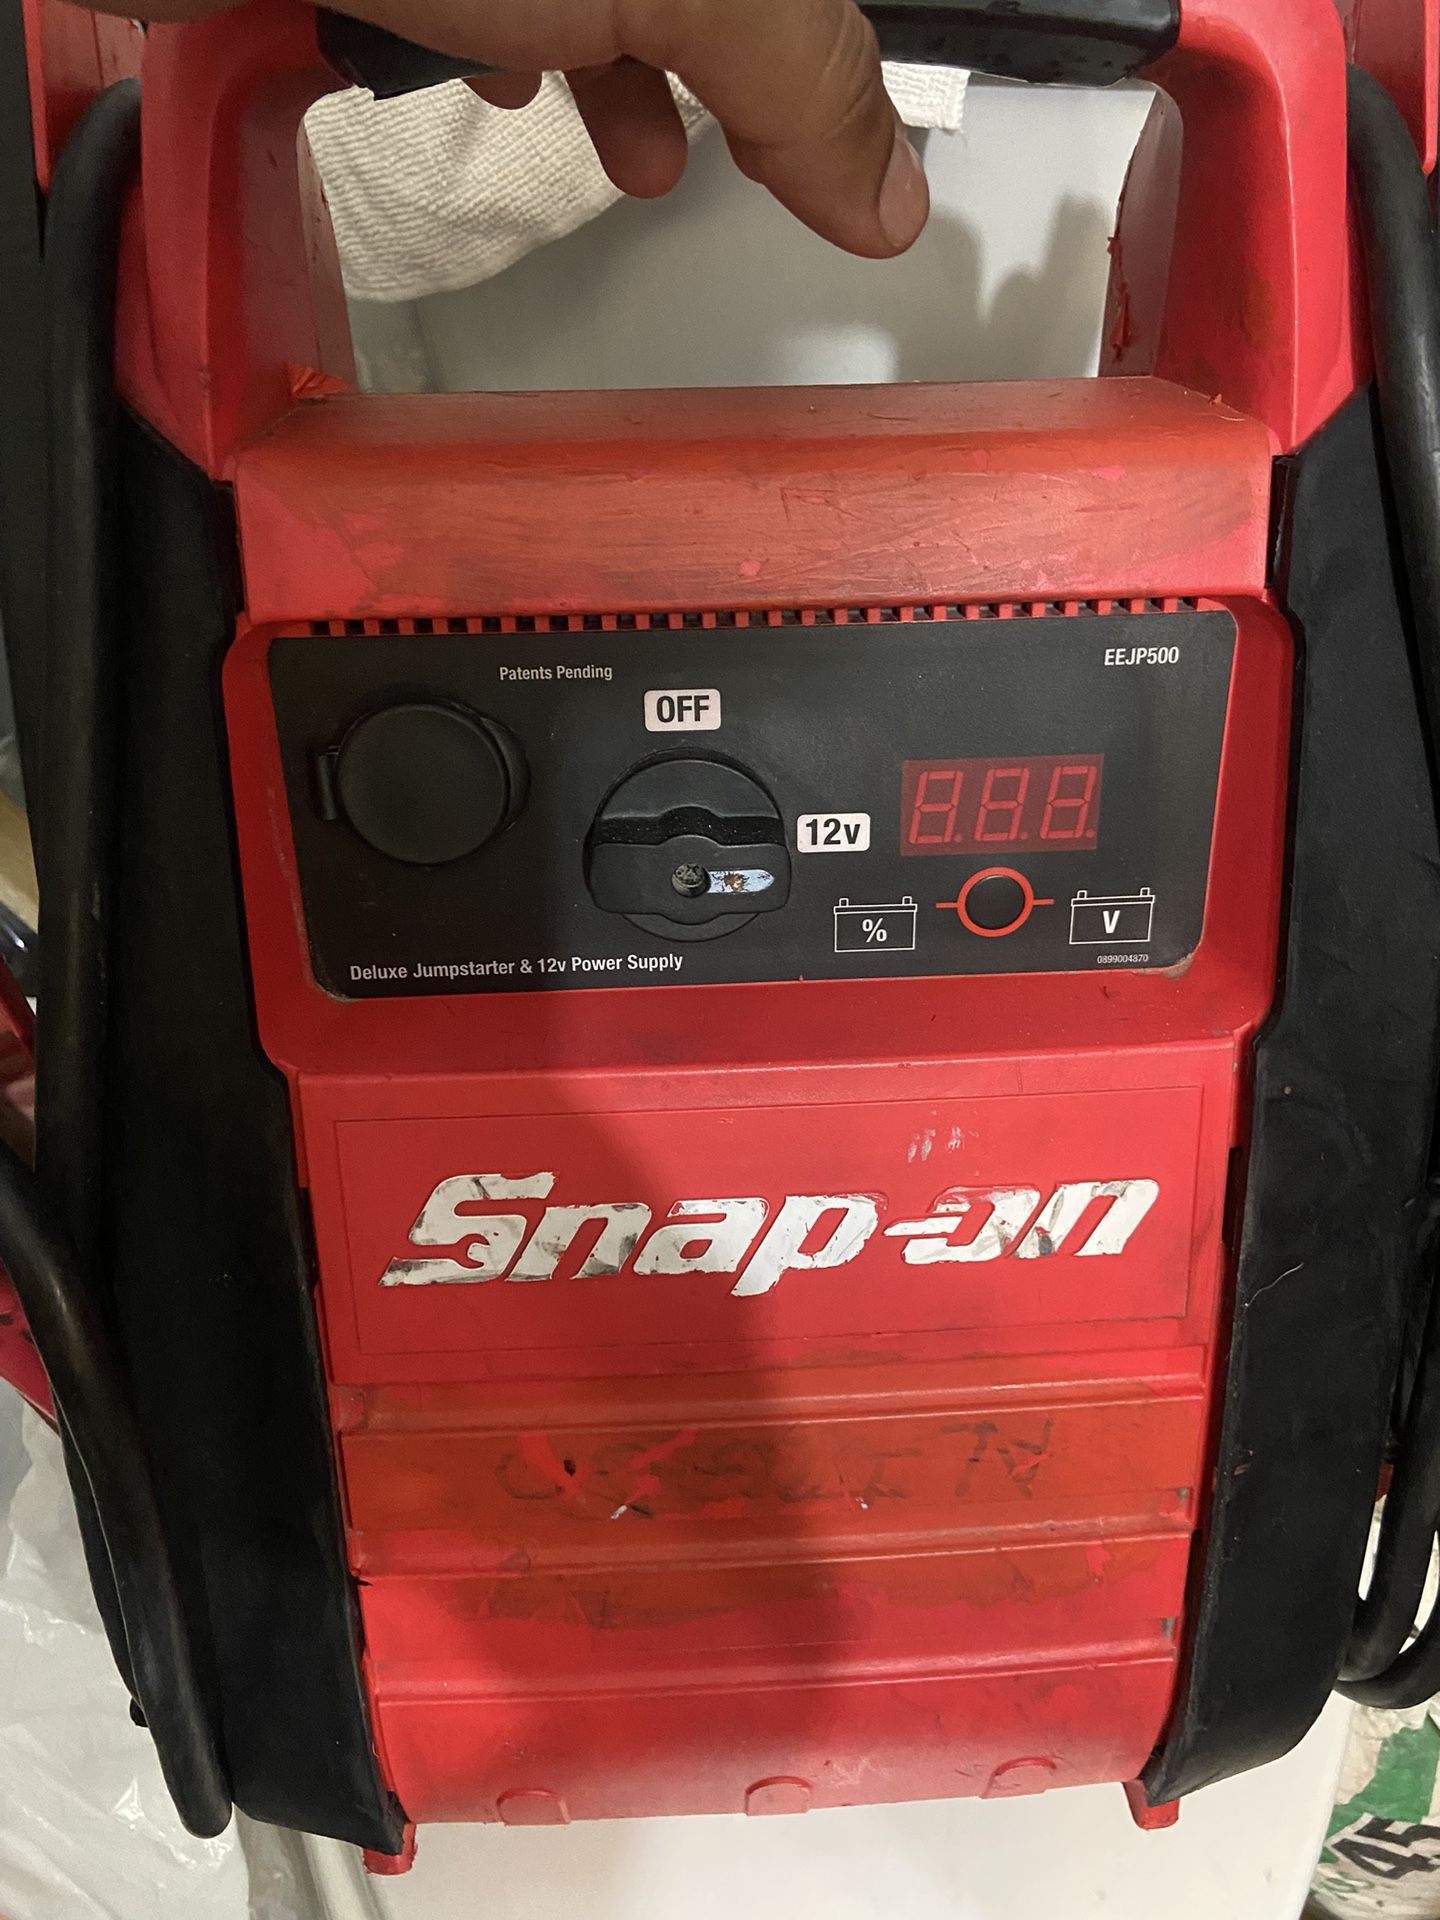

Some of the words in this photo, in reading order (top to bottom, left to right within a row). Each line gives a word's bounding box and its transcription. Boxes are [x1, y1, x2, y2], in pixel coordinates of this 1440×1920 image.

[1104, 646, 1180, 666] EEJP500
[499, 666, 553, 681] Patents
[556, 664, 613, 681] Pending
[656, 694, 710, 723] OFF
[805, 818, 861, 846] 12v
[862, 917, 888, 943] %
[1102, 910, 1120, 934] V
[350, 965, 408, 981] Deluxe
[412, 960, 515, 980] Jumpstarter
[519, 960, 533, 974] &
[537, 958, 567, 973] 12v
[571, 956, 623, 972] Power
[626, 953, 684, 972] Supply
[379, 1171, 1160, 1297] Snap-on
